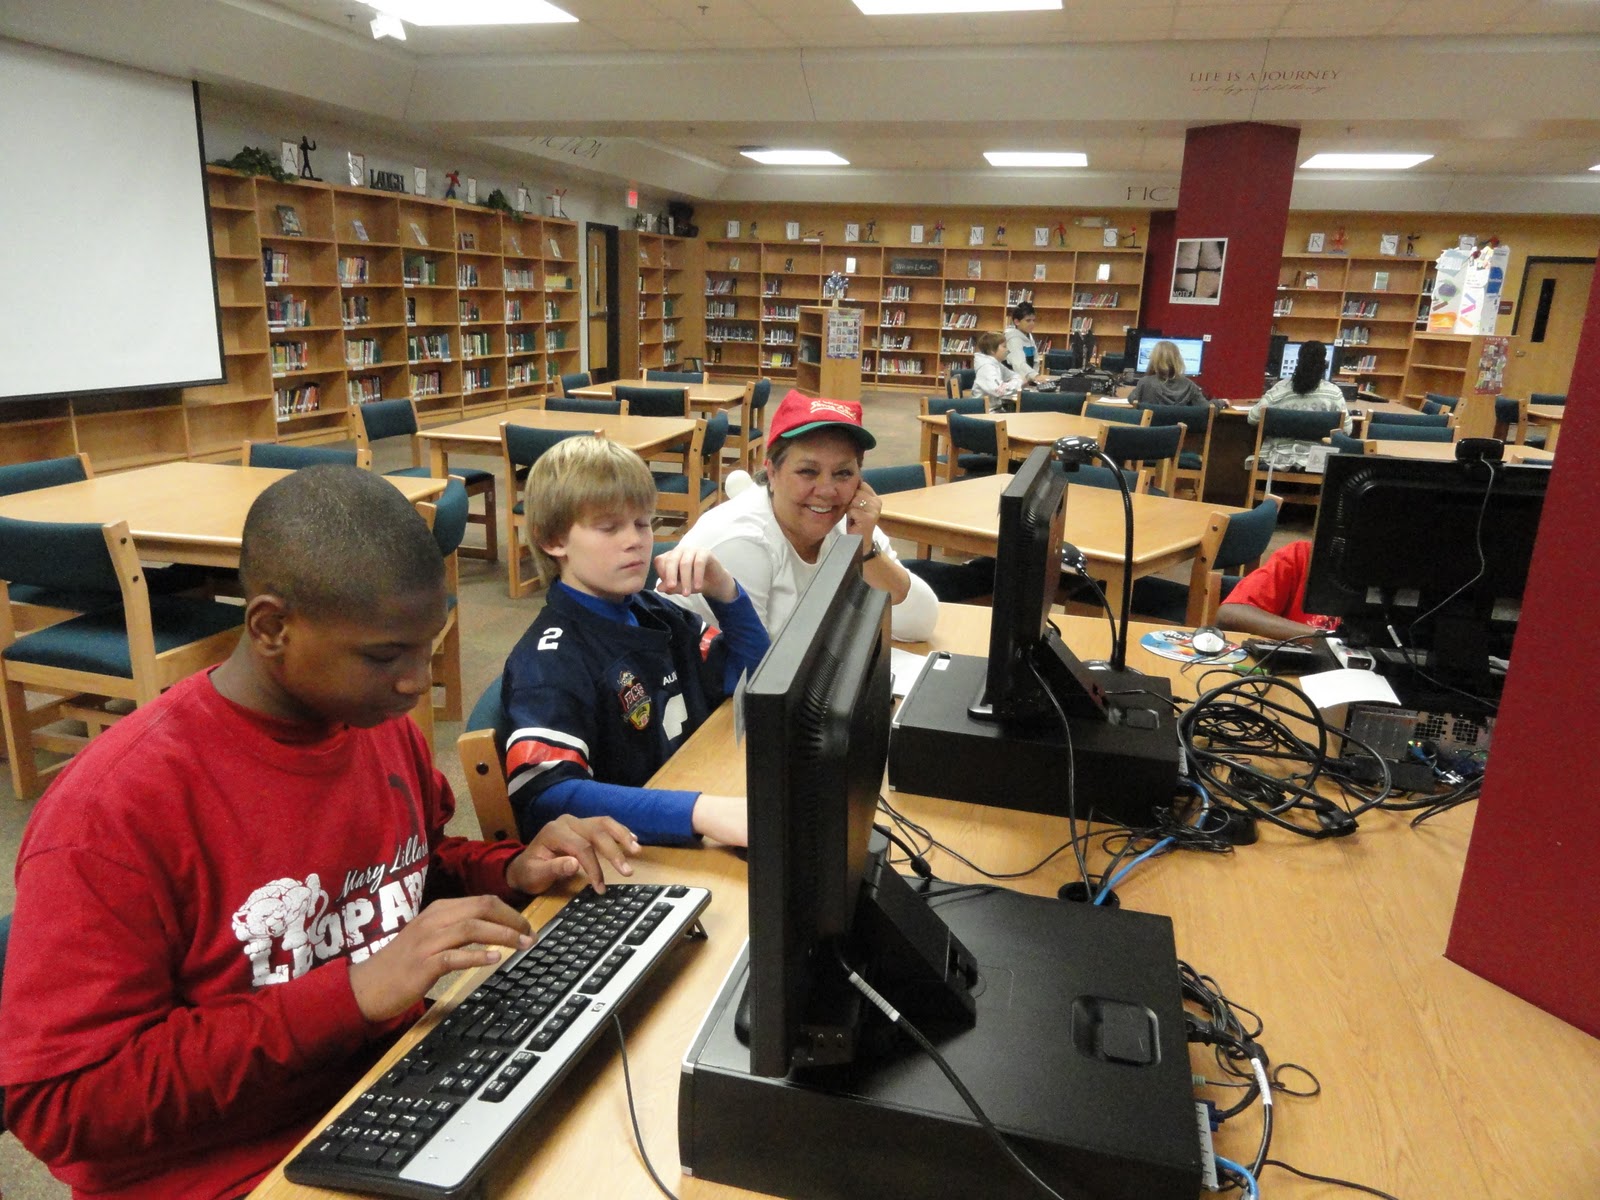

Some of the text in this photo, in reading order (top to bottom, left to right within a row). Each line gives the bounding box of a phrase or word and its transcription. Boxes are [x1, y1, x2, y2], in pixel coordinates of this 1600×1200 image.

[1190, 70, 1340, 82] LIFE IS A JOURNEY
[283, 147, 297, 169] A
[369, 168, 405, 192] LAUGH
[537, 627, 564, 651] 2
[336, 863, 386, 903] Mary
[250, 864, 428, 987] LEOPAR
